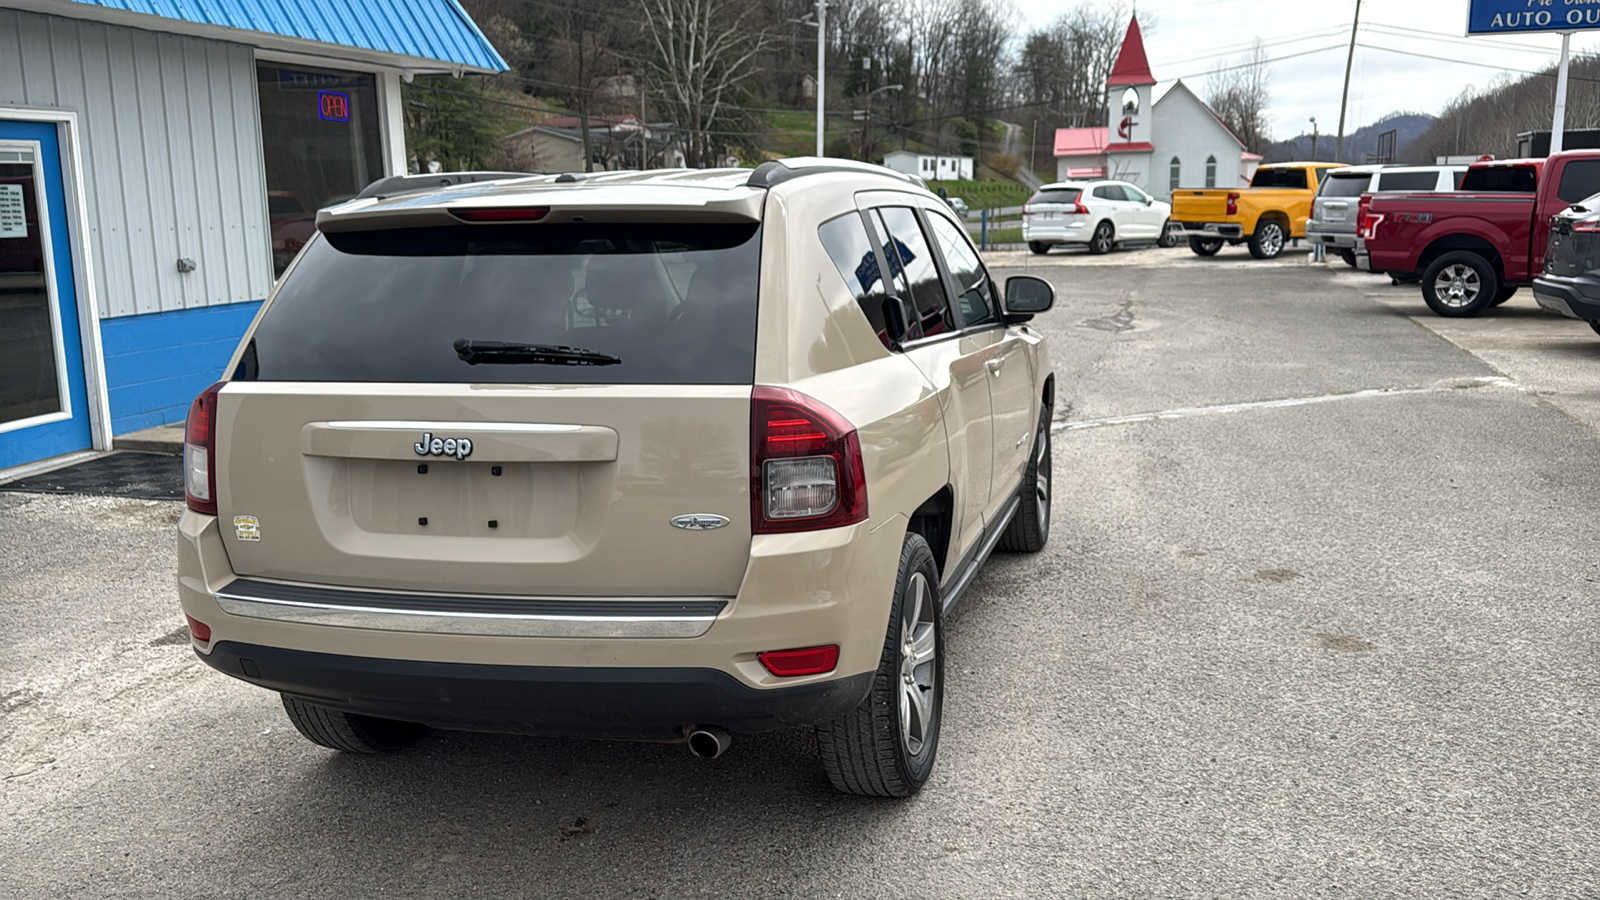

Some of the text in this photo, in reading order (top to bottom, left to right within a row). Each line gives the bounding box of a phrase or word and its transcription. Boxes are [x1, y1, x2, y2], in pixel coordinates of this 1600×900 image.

[1490, 10, 1552, 28] AUTO
[321, 94, 348, 118] OPEN
[414, 432, 473, 460] Jeep
